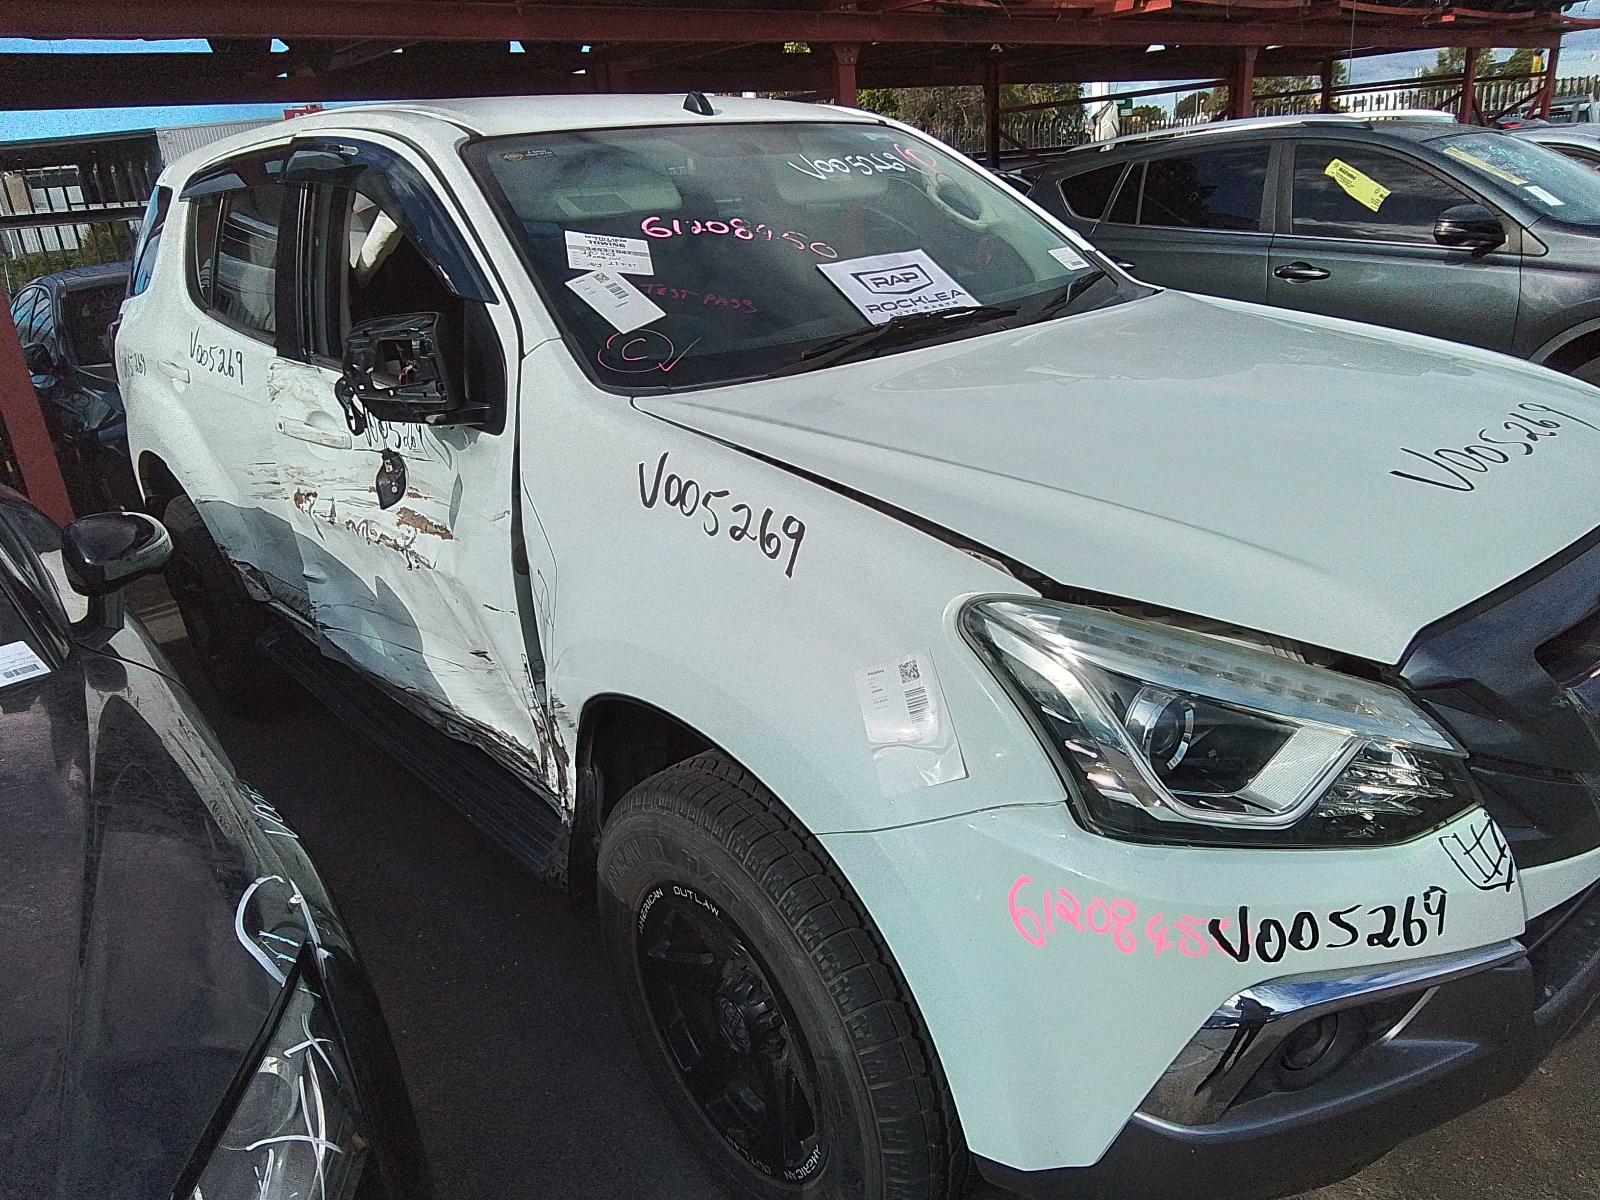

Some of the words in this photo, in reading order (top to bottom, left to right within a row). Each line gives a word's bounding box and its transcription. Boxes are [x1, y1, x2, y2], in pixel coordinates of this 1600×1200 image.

[864, 289, 966, 314] ROCKLEA
[869, 271, 920, 289] RAP
[889, 307, 919, 318] AUTO
[923, 300, 960, 312] PARTS
[190, 327, 244, 386] V005269
[1389, 402, 1600, 492] V005269
[638, 451, 806, 579] V005269
[637, 886, 664, 936] AMERICAN
[672, 885, 720, 917] OUTLAW
[1208, 886, 1448, 963] V005269
